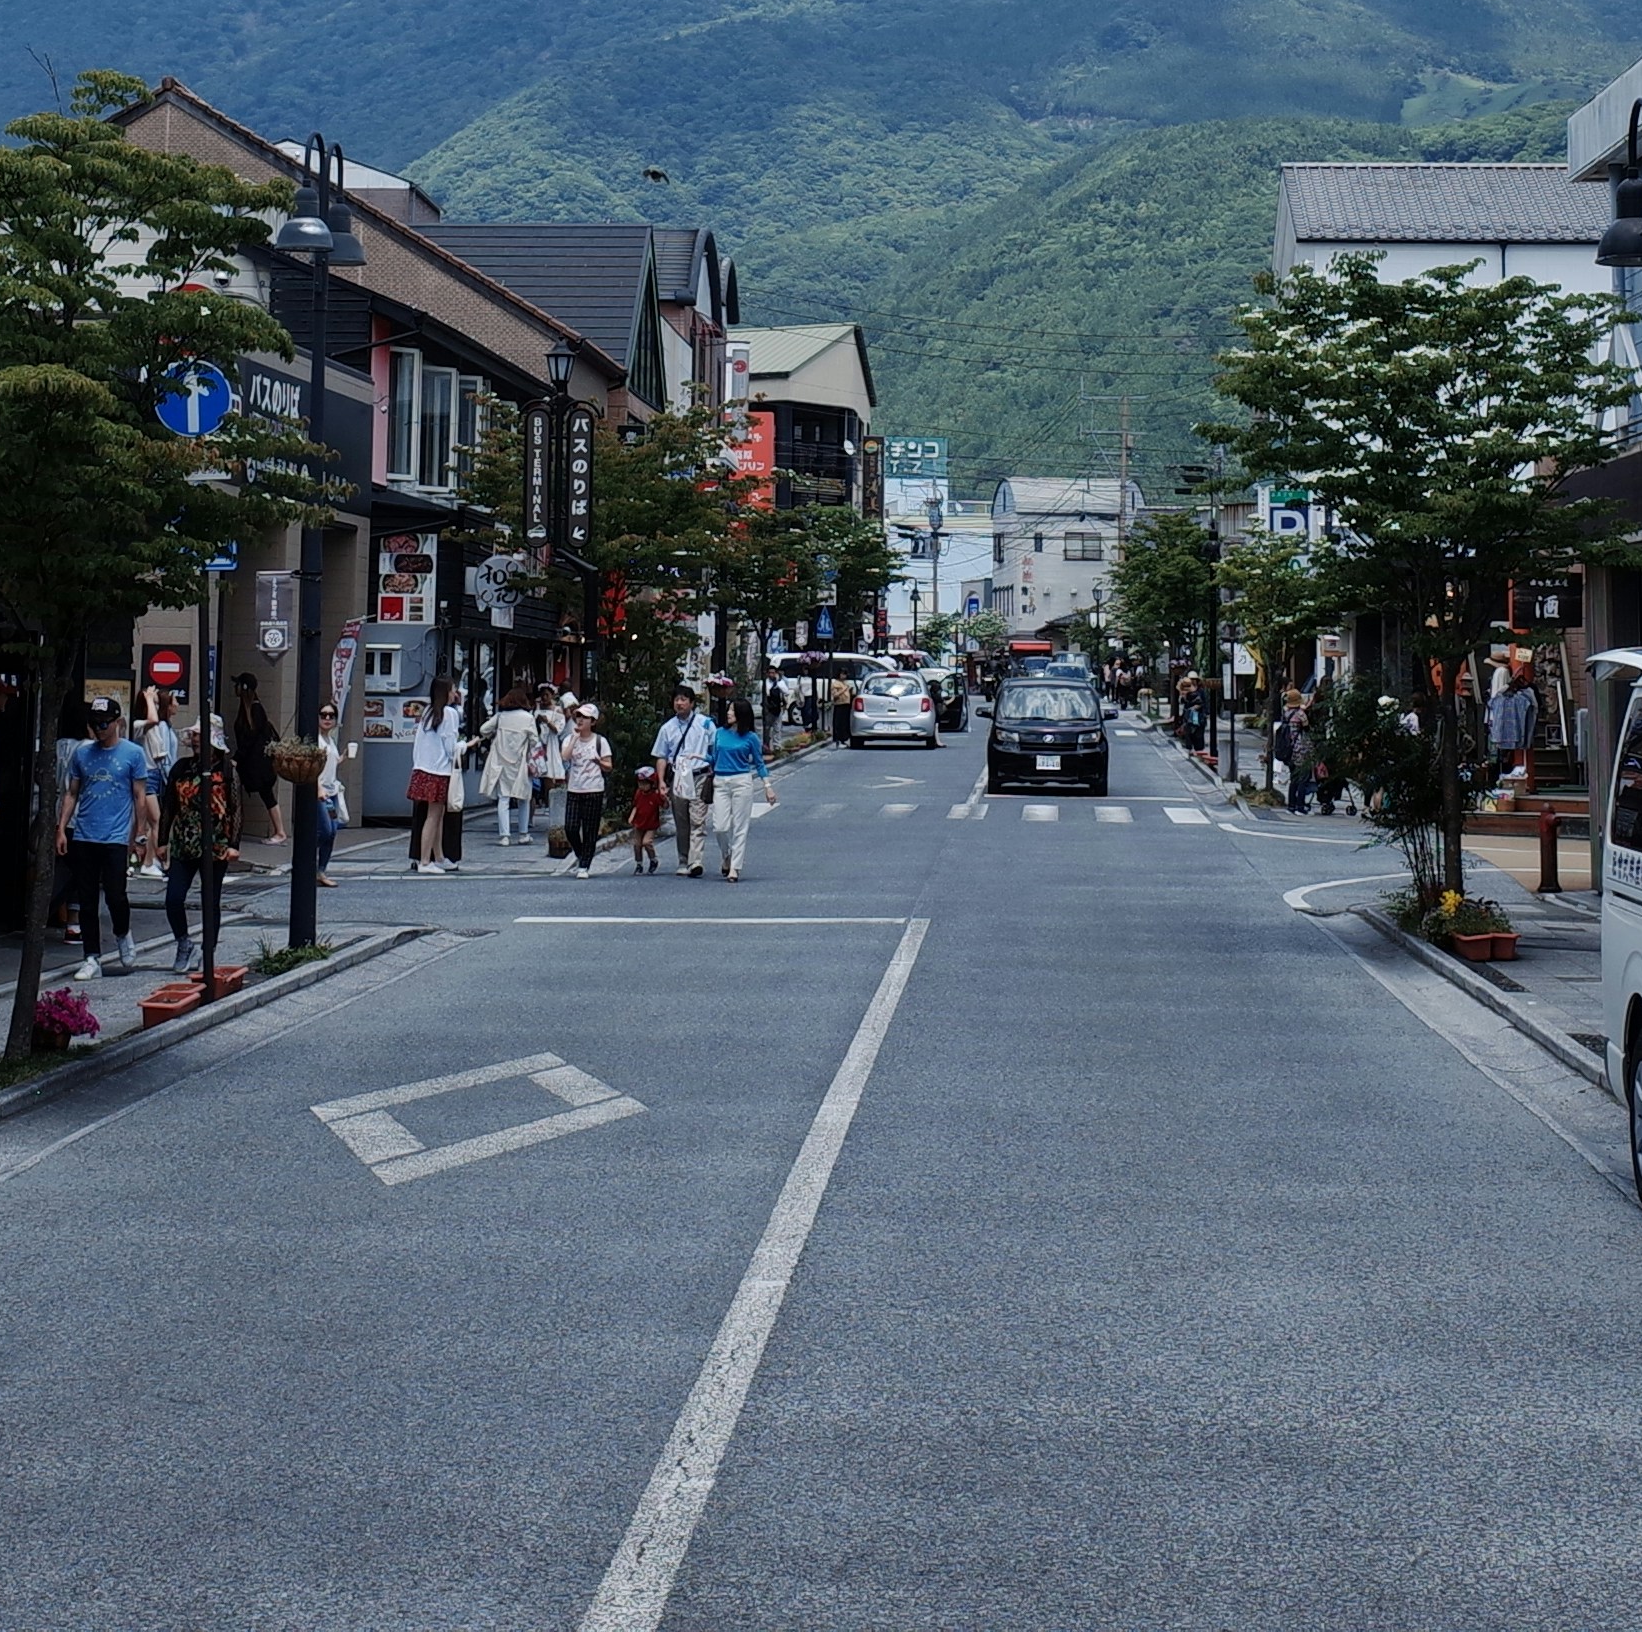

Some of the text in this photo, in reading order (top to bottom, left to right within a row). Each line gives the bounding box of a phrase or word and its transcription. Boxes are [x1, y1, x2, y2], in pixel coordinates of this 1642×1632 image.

[532, 416, 544, 523] BUS TERMINAL
[571, 417, 591, 516] バスのりば
[884, 441, 940, 459] チンコ
[1535, 594, 1560, 618] 酒
